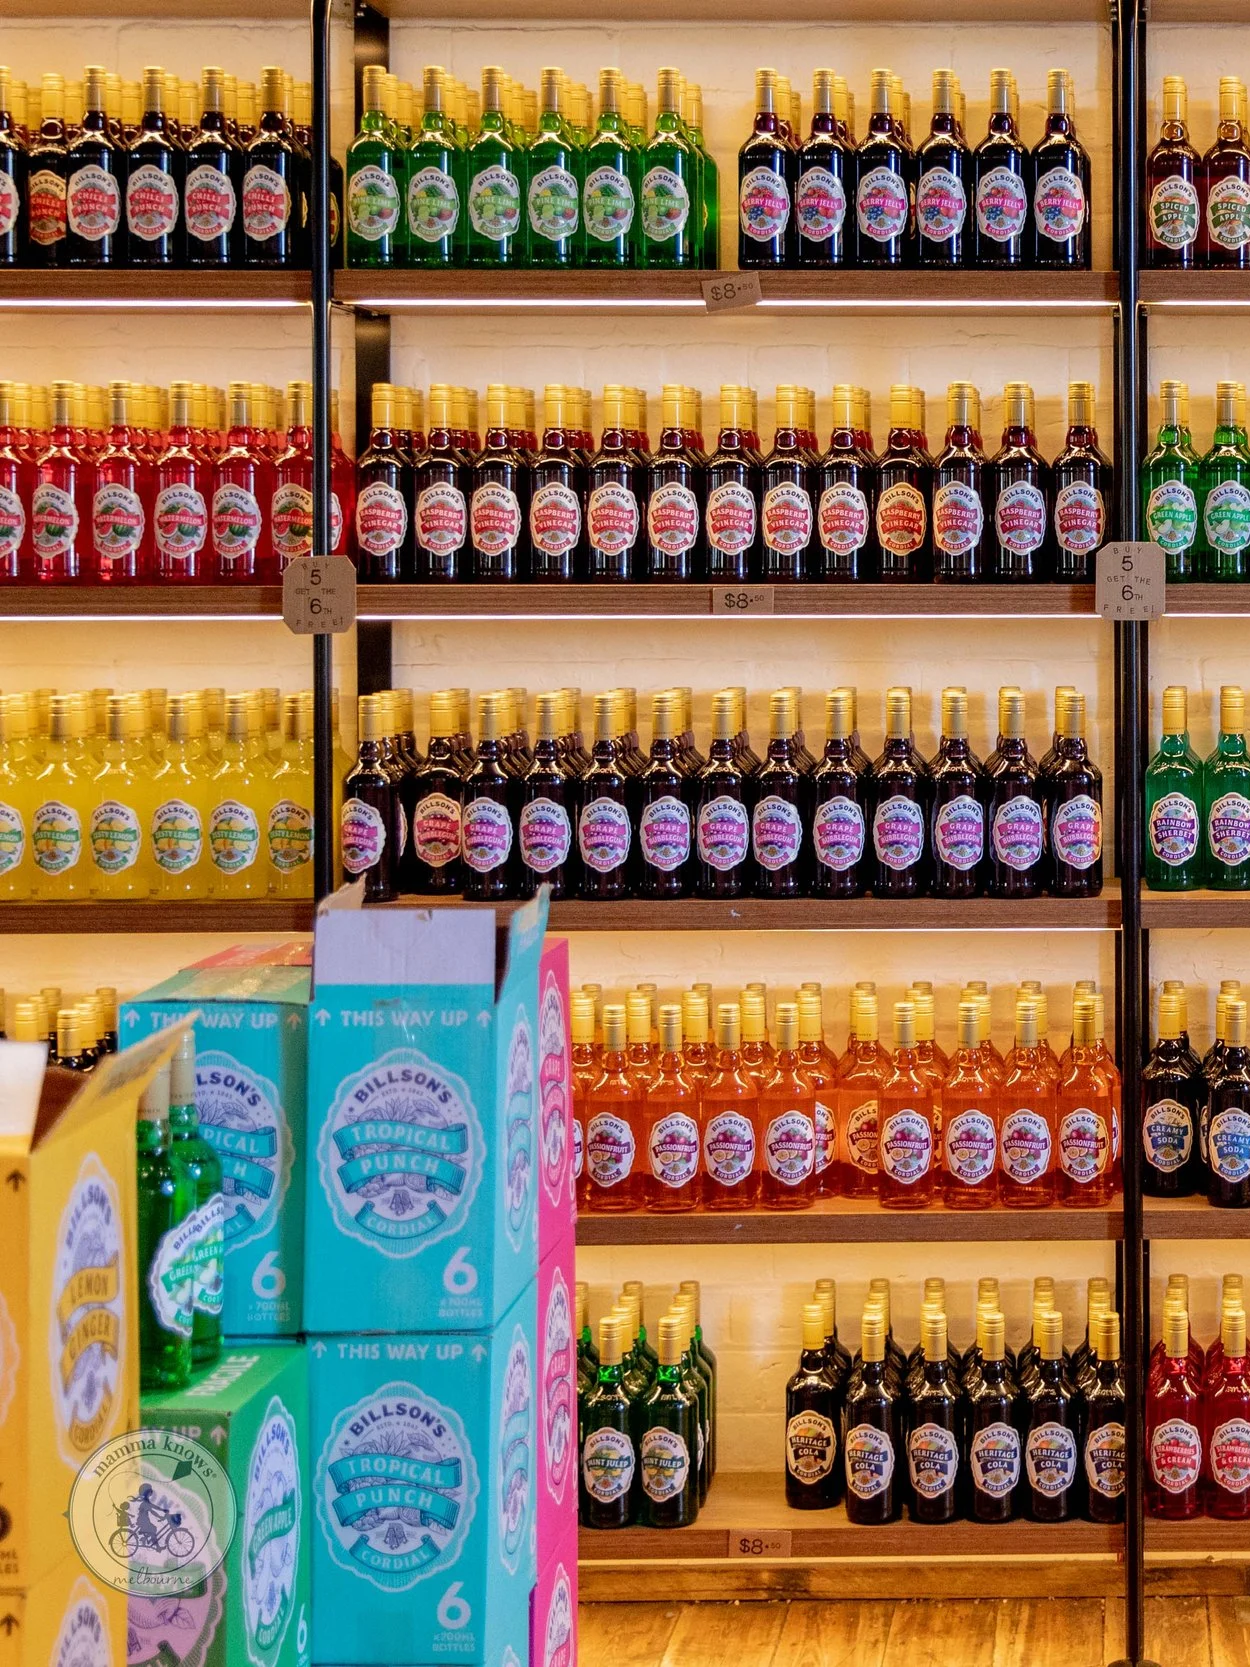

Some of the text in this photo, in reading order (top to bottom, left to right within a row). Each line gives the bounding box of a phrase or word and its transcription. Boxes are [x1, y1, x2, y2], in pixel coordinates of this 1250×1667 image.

[76, 173, 111, 186] BILLSON'S
[354, 173, 391, 188] BILLSON'S
[864, 174, 900, 188] BILLSON'S
[1157, 184, 1192, 197] BILLSON'S
[77, 194, 107, 203] CHILLI
[863, 199, 903, 209] BERRY JELLY
[77, 205, 109, 213] PUNCH
[1161, 203, 1189, 212] SPICED
[1162, 214, 1188, 222] APPLE
[867, 225, 895, 234] CORDIAL
[1161, 234, 1189, 244] CORDIAL
[161, 493, 198, 505] BILLSON'S
[424, 490, 460, 504] BILLSON'S
[159, 516, 202, 525] WATERMELON
[421, 510, 462, 520] RASPBERRY
[425, 521, 459, 529] VINEGAR
[166, 543, 192, 554] CORDIAL
[428, 540, 455, 550] CORDIAL
[1113, 546, 1142, 555] BUY
[1121, 556, 1133, 572] 5
[310, 569, 321, 586] 5
[1107, 576, 1150, 586] GET THE
[881, 803, 916, 816] BILLSON'S
[1215, 799, 1249, 812] BILLSON'S
[158, 807, 194, 820] BILLSON'S
[885, 821, 914, 830] GRAPE
[1215, 818, 1250, 826] RAINBOW
[175, 829, 198, 838] LEMON
[881, 834, 917, 842] BUBBLEGUM
[1215, 829, 1250, 838] SHERBET
[886, 852, 913, 862] CORDIAL
[1219, 849, 1247, 858] CORDIAL
[202, 1011, 244, 1029] WAY
[251, 1011, 279, 1028] UP
[341, 1010, 468, 1027] THIS WAY UP
[354, 1069, 453, 1104] BILLSON'S
[1007, 1117, 1042, 1130] BILLSON'S
[351, 1125, 450, 1149] TROPICAL
[1004, 1140, 1046, 1149] PASSIONFRUIT
[360, 1154, 440, 1174] PUNCH
[1011, 1167, 1038, 1178] CORDIAL
[66, 1185, 111, 1249] BILLSON'S
[365, 1215, 438, 1236] CORDIAL
[252, 1251, 286, 1299] 6
[443, 1247, 478, 1294] 6
[70, 1274, 109, 1300] LEMON
[69, 1316, 110, 1358] GINGER
[338, 1344, 463, 1360] THIS WAY UP
[351, 1403, 447, 1437] BILLSON'S
[590, 1436, 625, 1448] BILLSON'S
[980, 1431, 1015, 1444] BILLSON'S
[255, 1423, 290, 1483] BILLSON'S
[979, 1449, 1015, 1458] HERITAGE
[607, 1458, 630, 1468] JULEP
[987, 1461, 1008, 1469] COLA
[1222, 1456, 1227, 1464] &
[348, 1460, 446, 1484] TROPICAL
[985, 1480, 1011, 1490] CORDIAL
[1223, 1477, 1249, 1487] CORDIAL
[592, 1484, 622, 1496] CORDIAL
[355, 1490, 433, 1509] PUNCH
[275, 1509, 292, 1533] APPLE
[361, 1550, 430, 1570] CORDIAL
[437, 1581, 472, 1630] 6
[297, 1604, 307, 1652] 6
